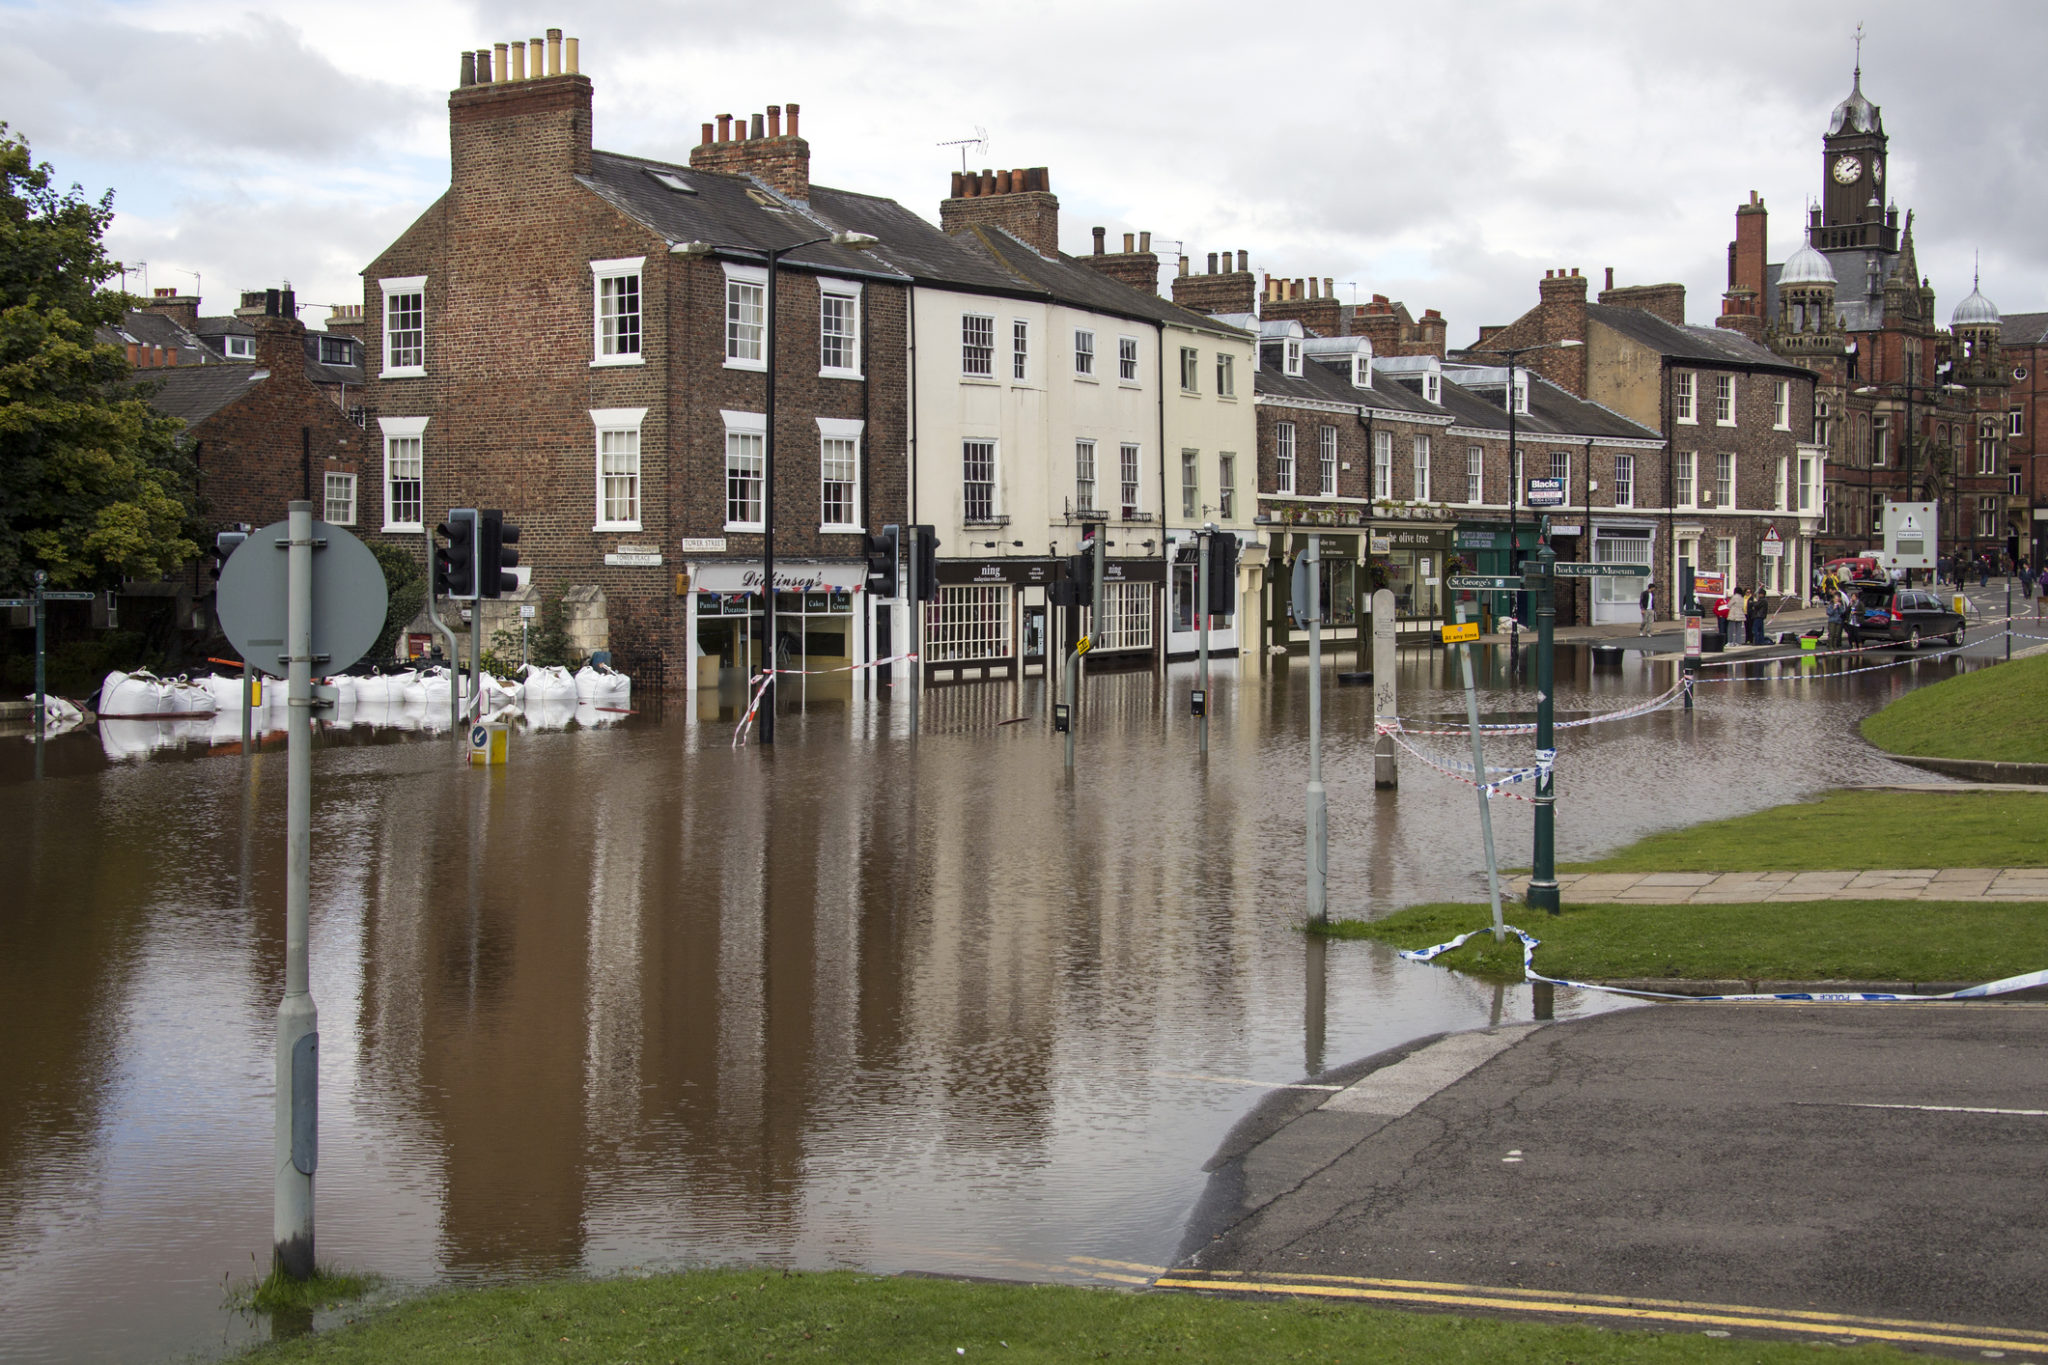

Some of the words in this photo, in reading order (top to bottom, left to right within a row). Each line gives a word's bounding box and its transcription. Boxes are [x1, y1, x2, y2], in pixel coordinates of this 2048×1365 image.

[1531, 480, 1560, 488] Blacks
[1398, 531, 1414, 544] olive
[1416, 532, 1429, 544] tree
[705, 539, 724, 547] STREET
[982, 564, 1000, 577] ning
[1556, 565, 1574, 574] York
[1576, 566, 1599, 575] Castle
[1602, 566, 1635, 576] Museum
[1461, 578, 1492, 588] George's
[699, 601, 719, 609] Panini
